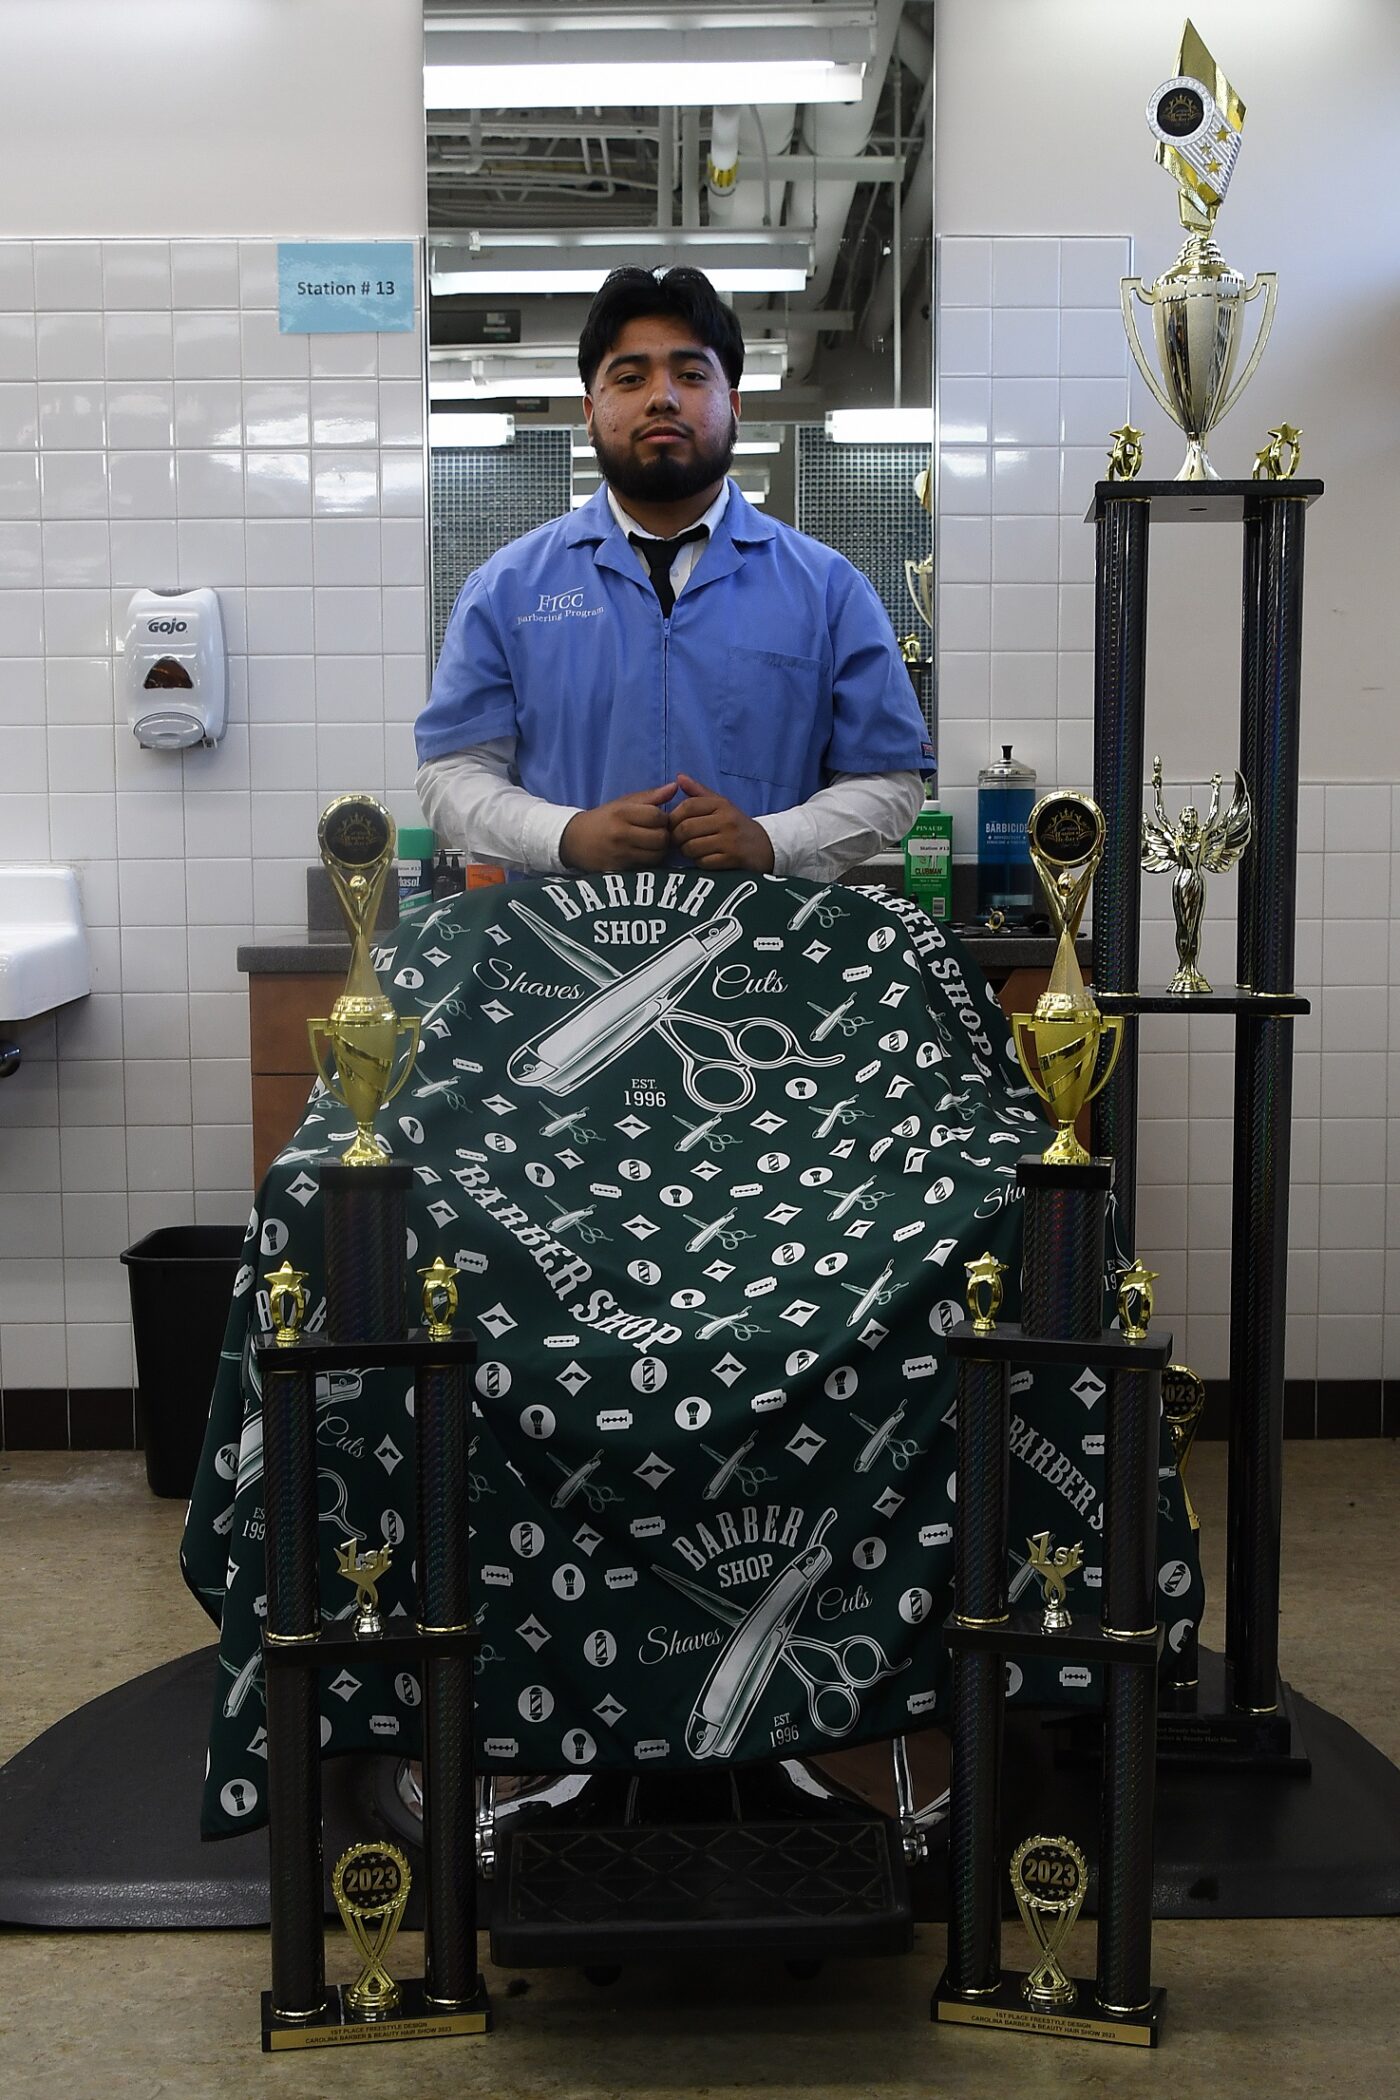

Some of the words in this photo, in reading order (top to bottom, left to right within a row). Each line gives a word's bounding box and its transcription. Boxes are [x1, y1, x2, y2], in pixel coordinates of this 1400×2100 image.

[297, 281, 356, 295] Station
[361, 281, 370, 295] #
[376, 281, 395, 295] 13
[147, 616, 188, 634] GOJO
[565, 606, 604, 618] Program
[541, 871, 715, 922] BARBER
[593, 919, 668, 945] SHOP
[472, 957, 585, 1000] Shaves
[711, 964, 788, 1000] Cuts
[927, 957, 993, 1055] SHOP
[623, 1090, 667, 1108] 1996
[449, 1164, 593, 1301] BARBER
[568, 1289, 683, 1355] SHOP
[316, 1411, 365, 1458] Cuts
[242, 1520, 266, 1540] 199
[672, 1505, 805, 1571] BARBER
[338, 1537, 394, 1573] 1st
[1031, 1530, 1084, 1567] 1st
[717, 1553, 774, 1588] SHOP
[816, 1585, 873, 1621] Cuts
[638, 1626, 723, 1665] Shaves
[769, 1725, 800, 1748] 1996
[345, 1866, 398, 1892] 2023
[1025, 1858, 1077, 1886] 2023
[365, 2024, 401, 2032] FREESTYLE
[971, 2015, 1003, 2025] CAROLINA
[1004, 2019, 1030, 2027] BARBER
[1037, 2023, 1063, 2031] BEAUTY
[1081, 2028, 1101, 2036] SHOW
[1008, 2013, 1028, 2021] PLACE
[1030, 2016, 1065, 2026] FREESTYLE
[1067, 2021, 1091, 2029] DESIGN
[305, 2035, 338, 2044] CAROLINA
